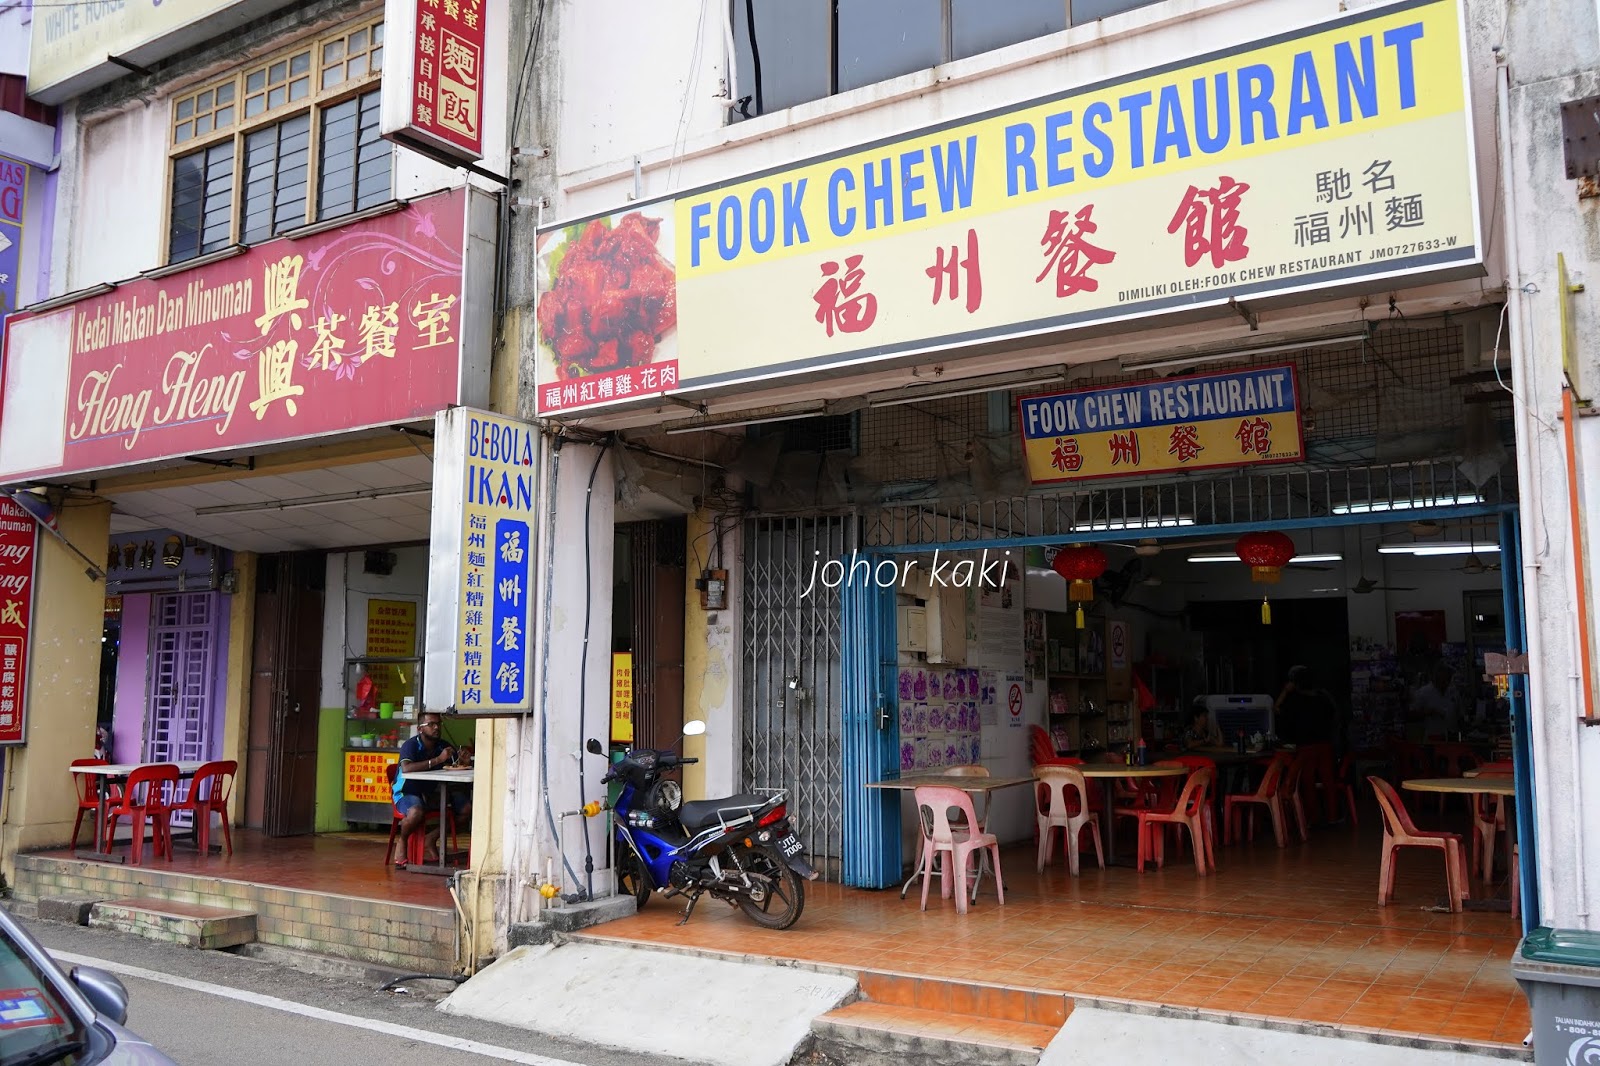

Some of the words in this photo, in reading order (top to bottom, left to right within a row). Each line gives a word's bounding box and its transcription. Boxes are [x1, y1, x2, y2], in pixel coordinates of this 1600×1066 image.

[45, 5, 79, 44] WHITE
[417, 10, 436, 126] 承接自由餐
[691, 178, 810, 268] FOOK
[828, 135, 978, 237] CHEW
[1005, 21, 1424, 197] RESTAURANT
[1315, 159, 1396, 204] 馳名
[1294, 193, 1425, 248] 福州麵
[812, 176, 1250, 338] 福州餐館
[1118, 284, 1167, 302] DIMILIKI
[1240, 265, 1276, 282] CHEW
[1279, 250, 1362, 275] RESTAURANT
[1369, 236, 1457, 260] JM0727633-W
[76, 306, 112, 354] Kedai
[111, 295, 156, 344] Makan
[156, 290, 184, 335] Dan
[185, 277, 253, 328] Minuman
[308, 293, 457, 371] 茶餐室
[70, 363, 153, 450] Heng
[154, 343, 247, 435] Heng
[1027, 399, 1081, 435] FOOK
[1084, 391, 1142, 428] CHEW
[1149, 373, 1285, 421] RESTAURANT
[469, 418, 533, 467] BEBOLA
[1050, 416, 1272, 473] 福州餐館
[468, 465, 532, 512] IKAN
[0, 533, 30, 564] eng
[0, 563, 29, 594] eng
[495, 530, 524, 694] 福州餐館
[782, 835, 796, 848] JTD
[784, 841, 803, 857] 7006
